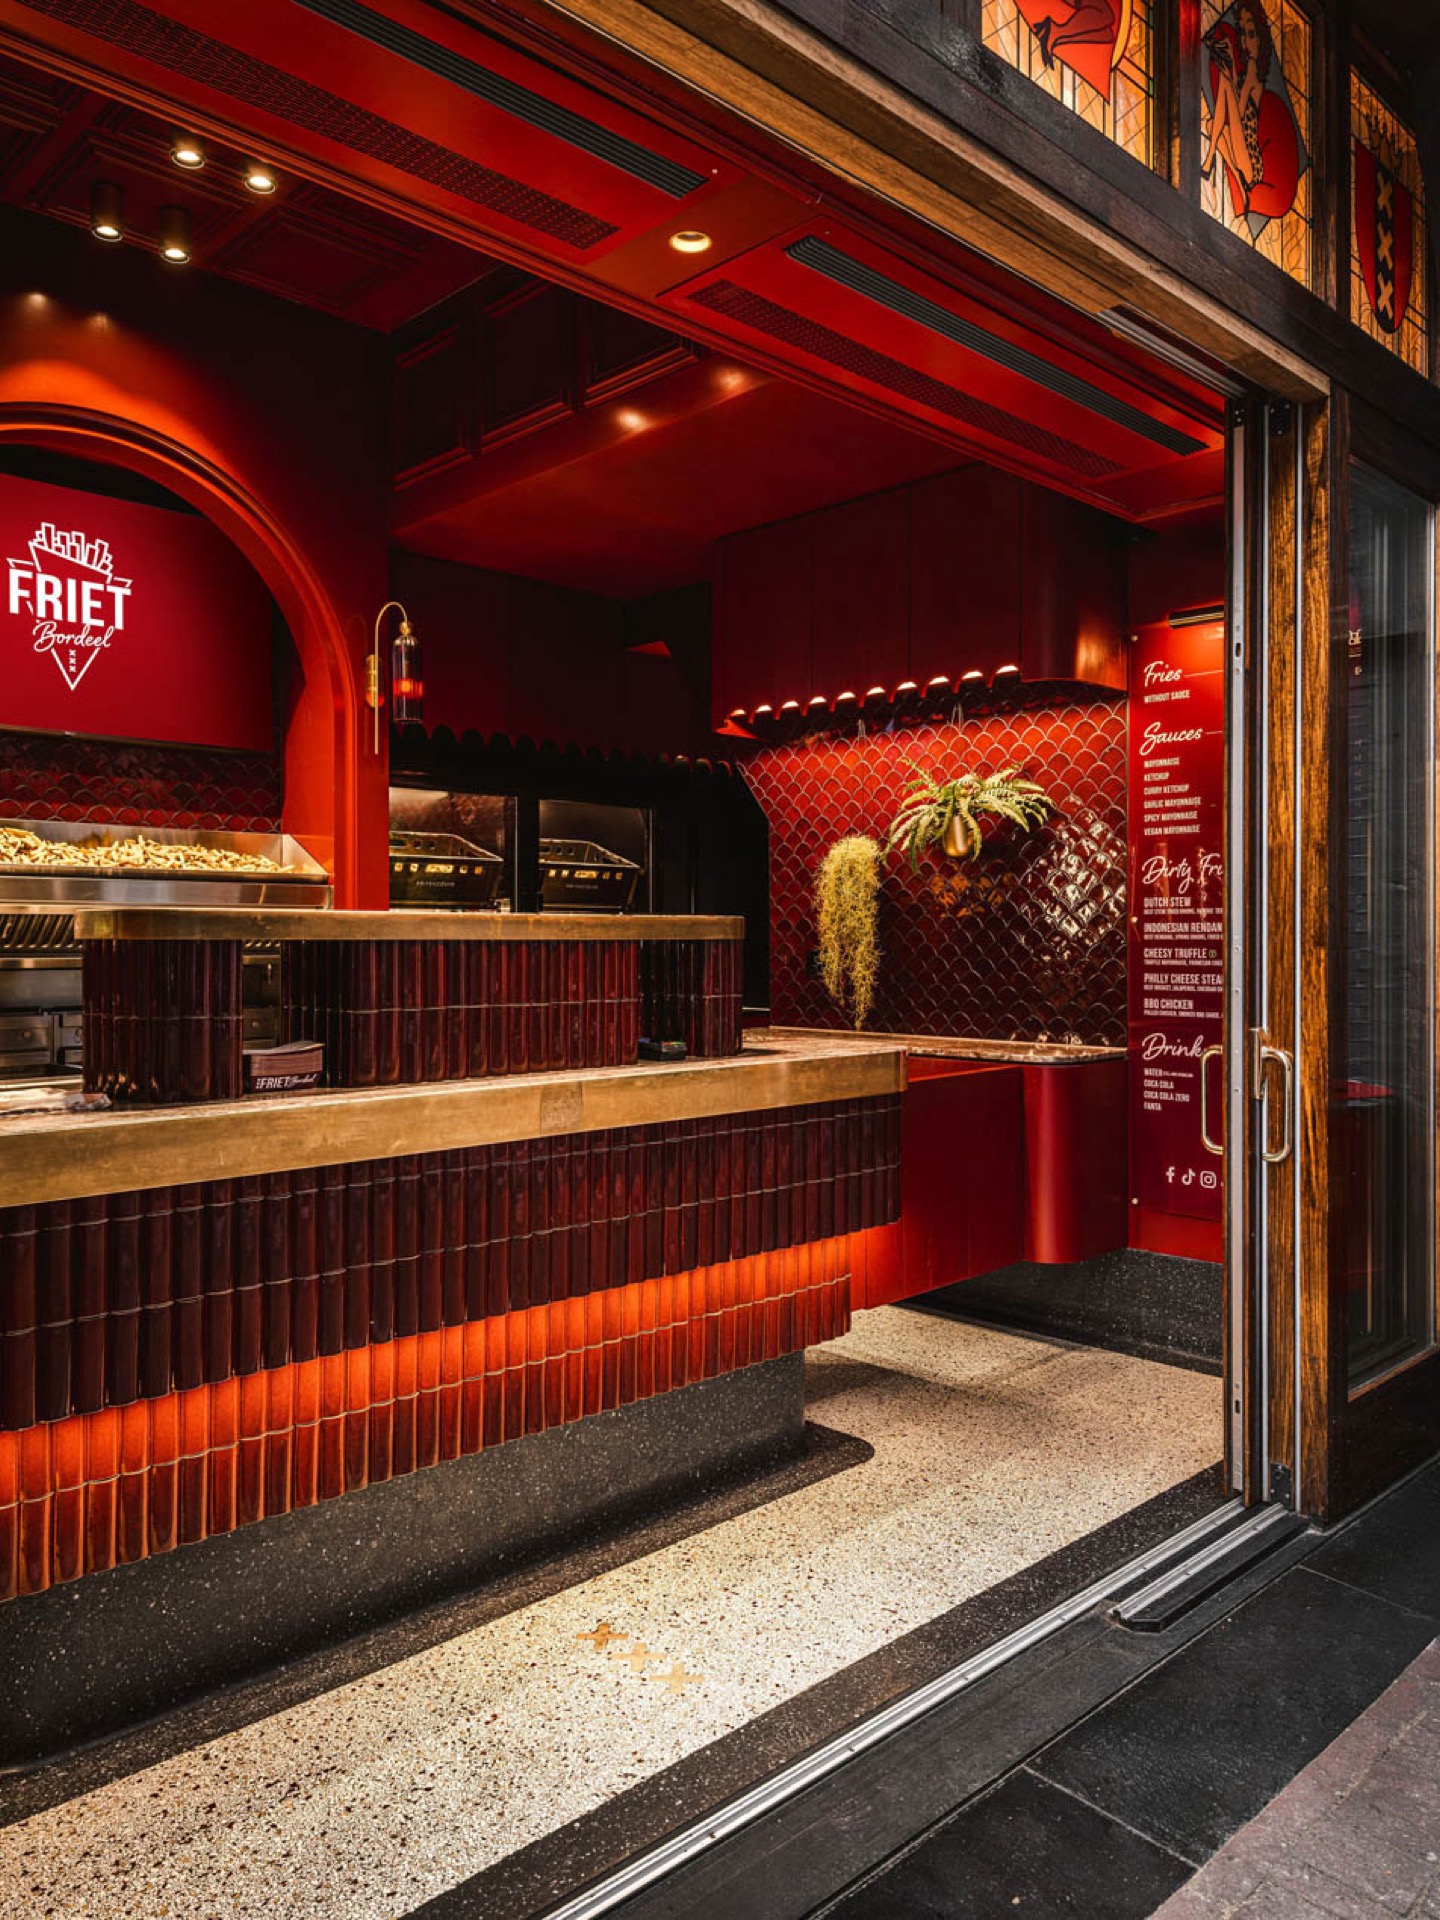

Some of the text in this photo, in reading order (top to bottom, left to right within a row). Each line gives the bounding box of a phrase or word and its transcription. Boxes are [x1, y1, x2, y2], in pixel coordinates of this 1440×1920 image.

[9, 568, 132, 631] FRIET
[32, 619, 115, 653] Bordeel
[1144, 661, 1182, 688] Fries
[1140, 722, 1202, 756] Sauces
[1142, 856, 1194, 894] Dirty
[1144, 897, 1168, 908] DUTCH
[1144, 923, 1188, 932] INDONESIAN
[1144, 949, 1206, 958] CHEESY TRUFFLE
[1144, 974, 1168, 984] PHILLY
[1170, 974, 1200, 984] CHEESE
[1160, 1000, 1194, 1010] CHICKEN
[259, 1076, 290, 1090] FRIET
